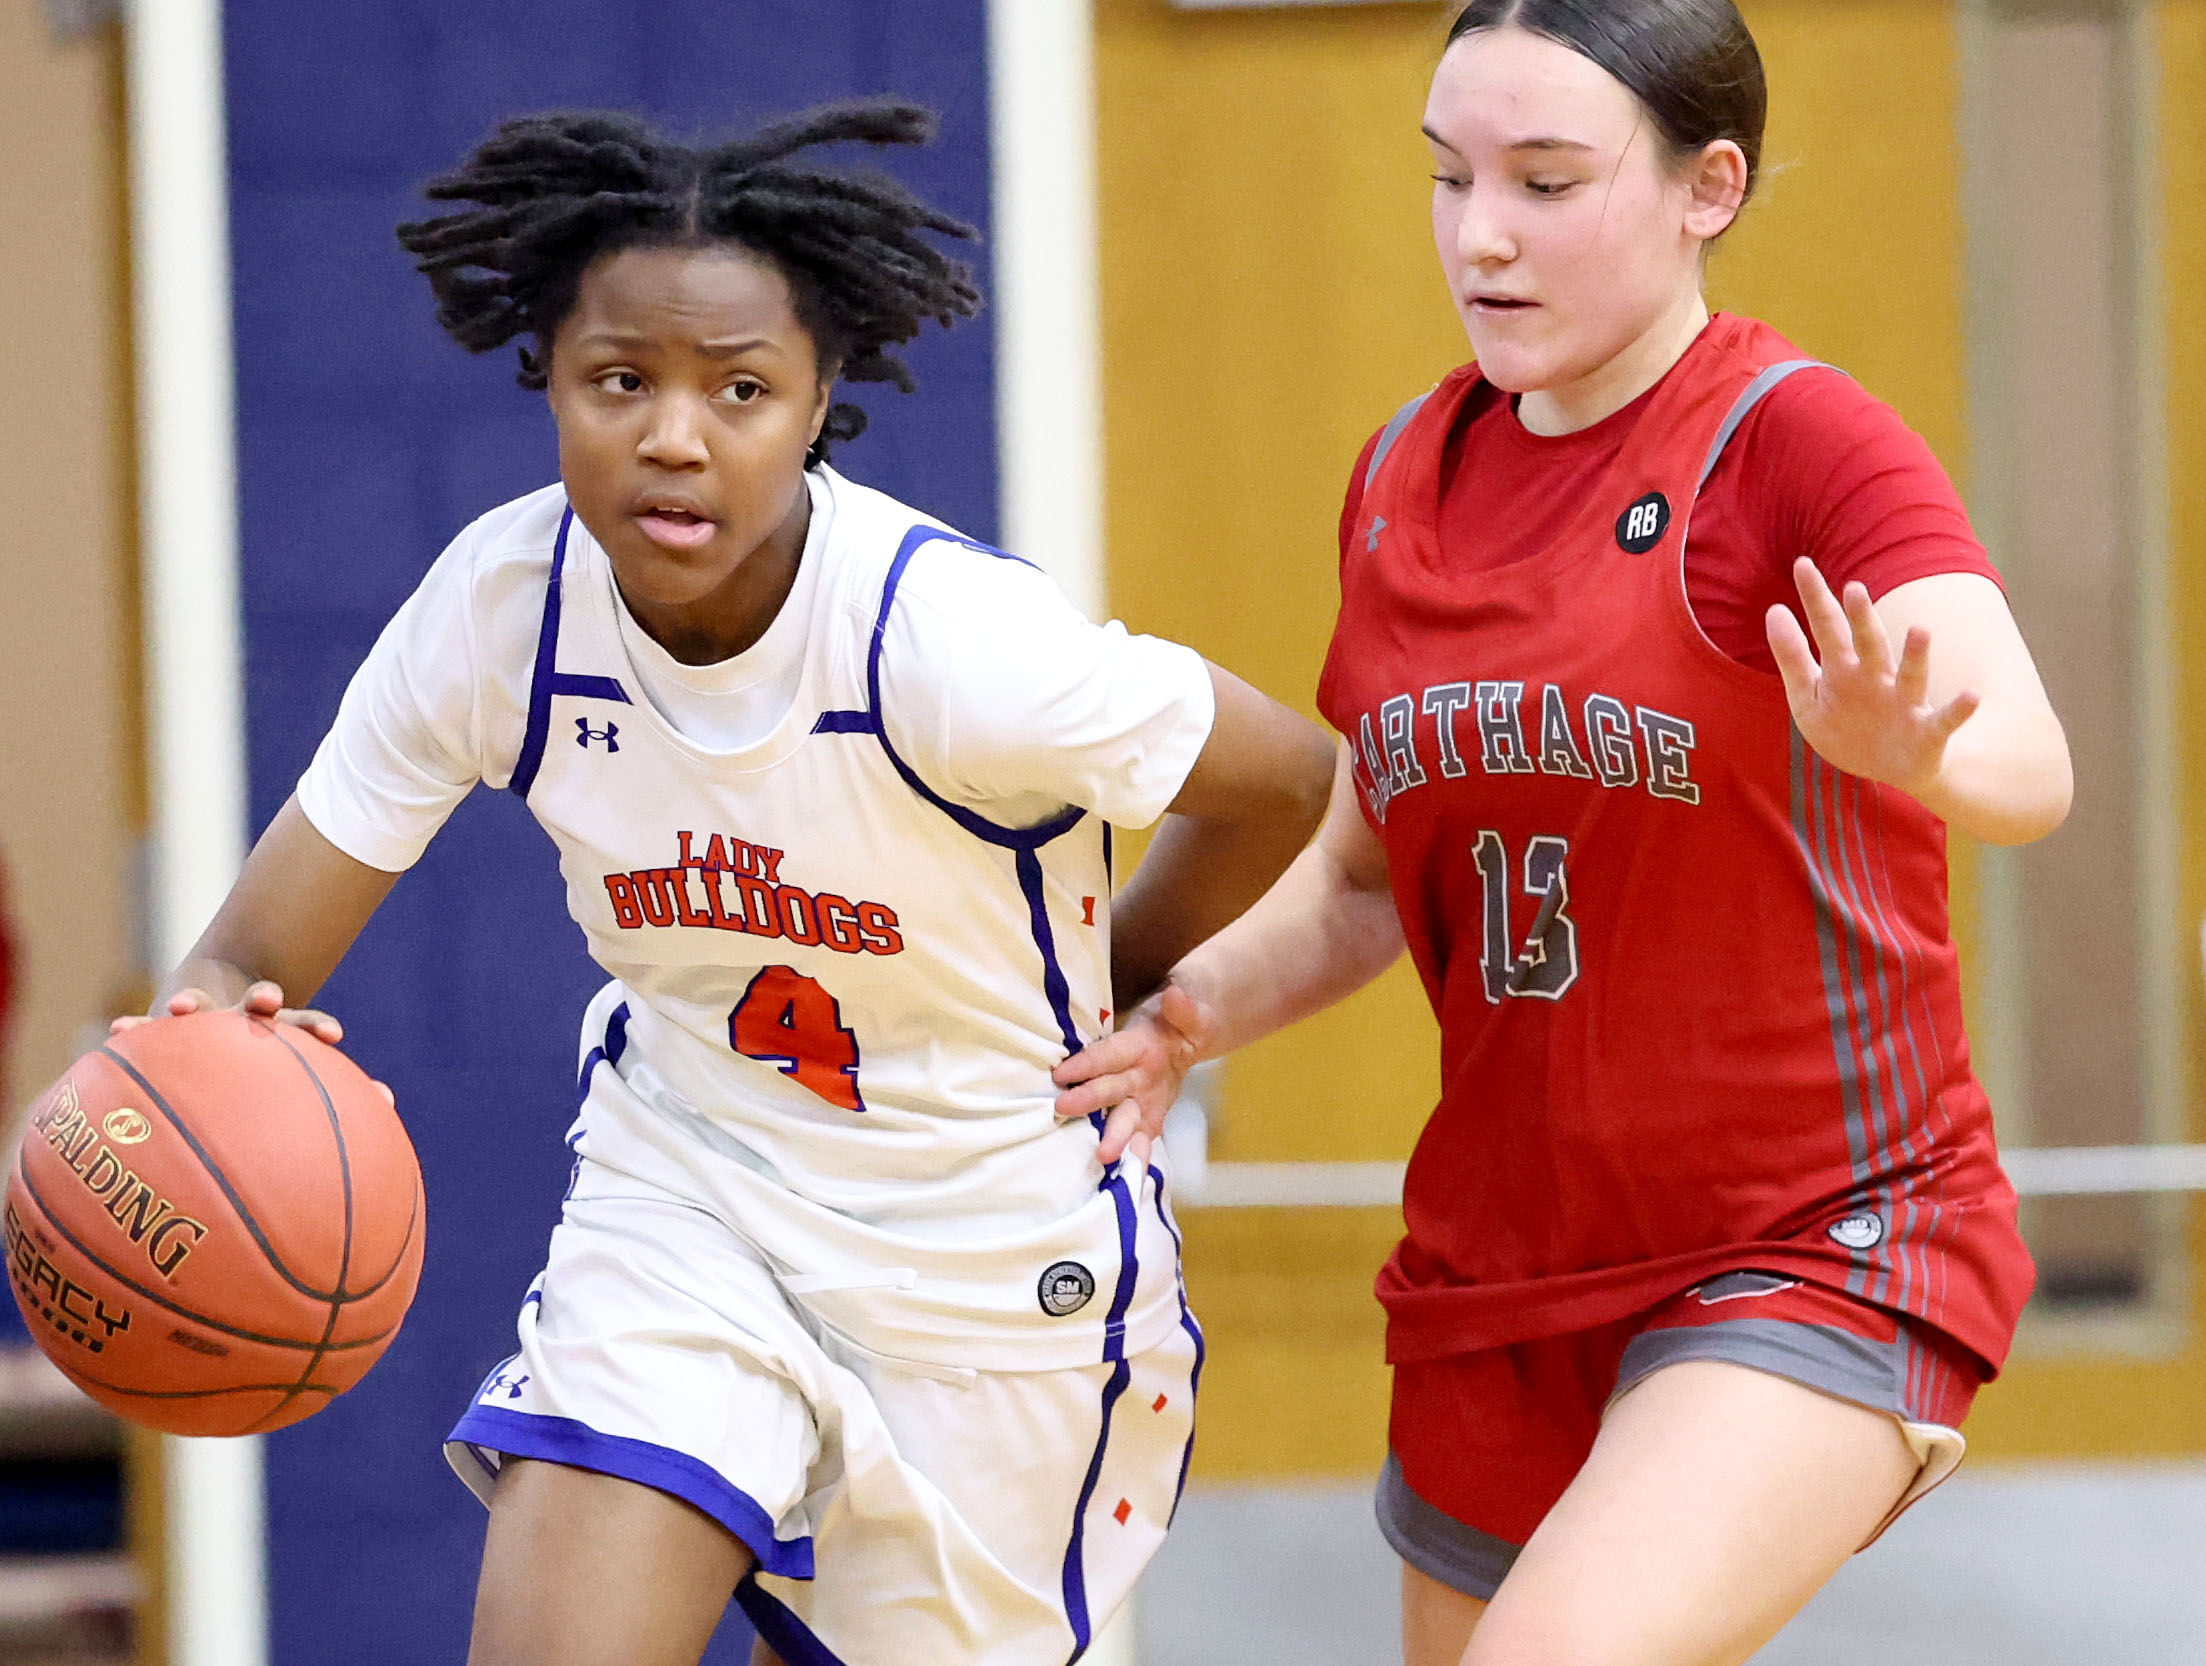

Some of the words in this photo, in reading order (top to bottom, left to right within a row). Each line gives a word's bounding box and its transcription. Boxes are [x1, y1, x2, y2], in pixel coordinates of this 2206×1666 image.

[1626, 502, 1659, 541] RB
[1352, 682, 1700, 825] ARTHAGE
[604, 867, 905, 956] BULLDOGS
[677, 831, 784, 884] LADY
[1471, 829, 1581, 1006] 13
[728, 965, 866, 1113] 4
[34, 1077, 209, 1278] PALDING
[6, 1202, 132, 1337] EGACY
[1056, 1280, 1080, 1294] SM
